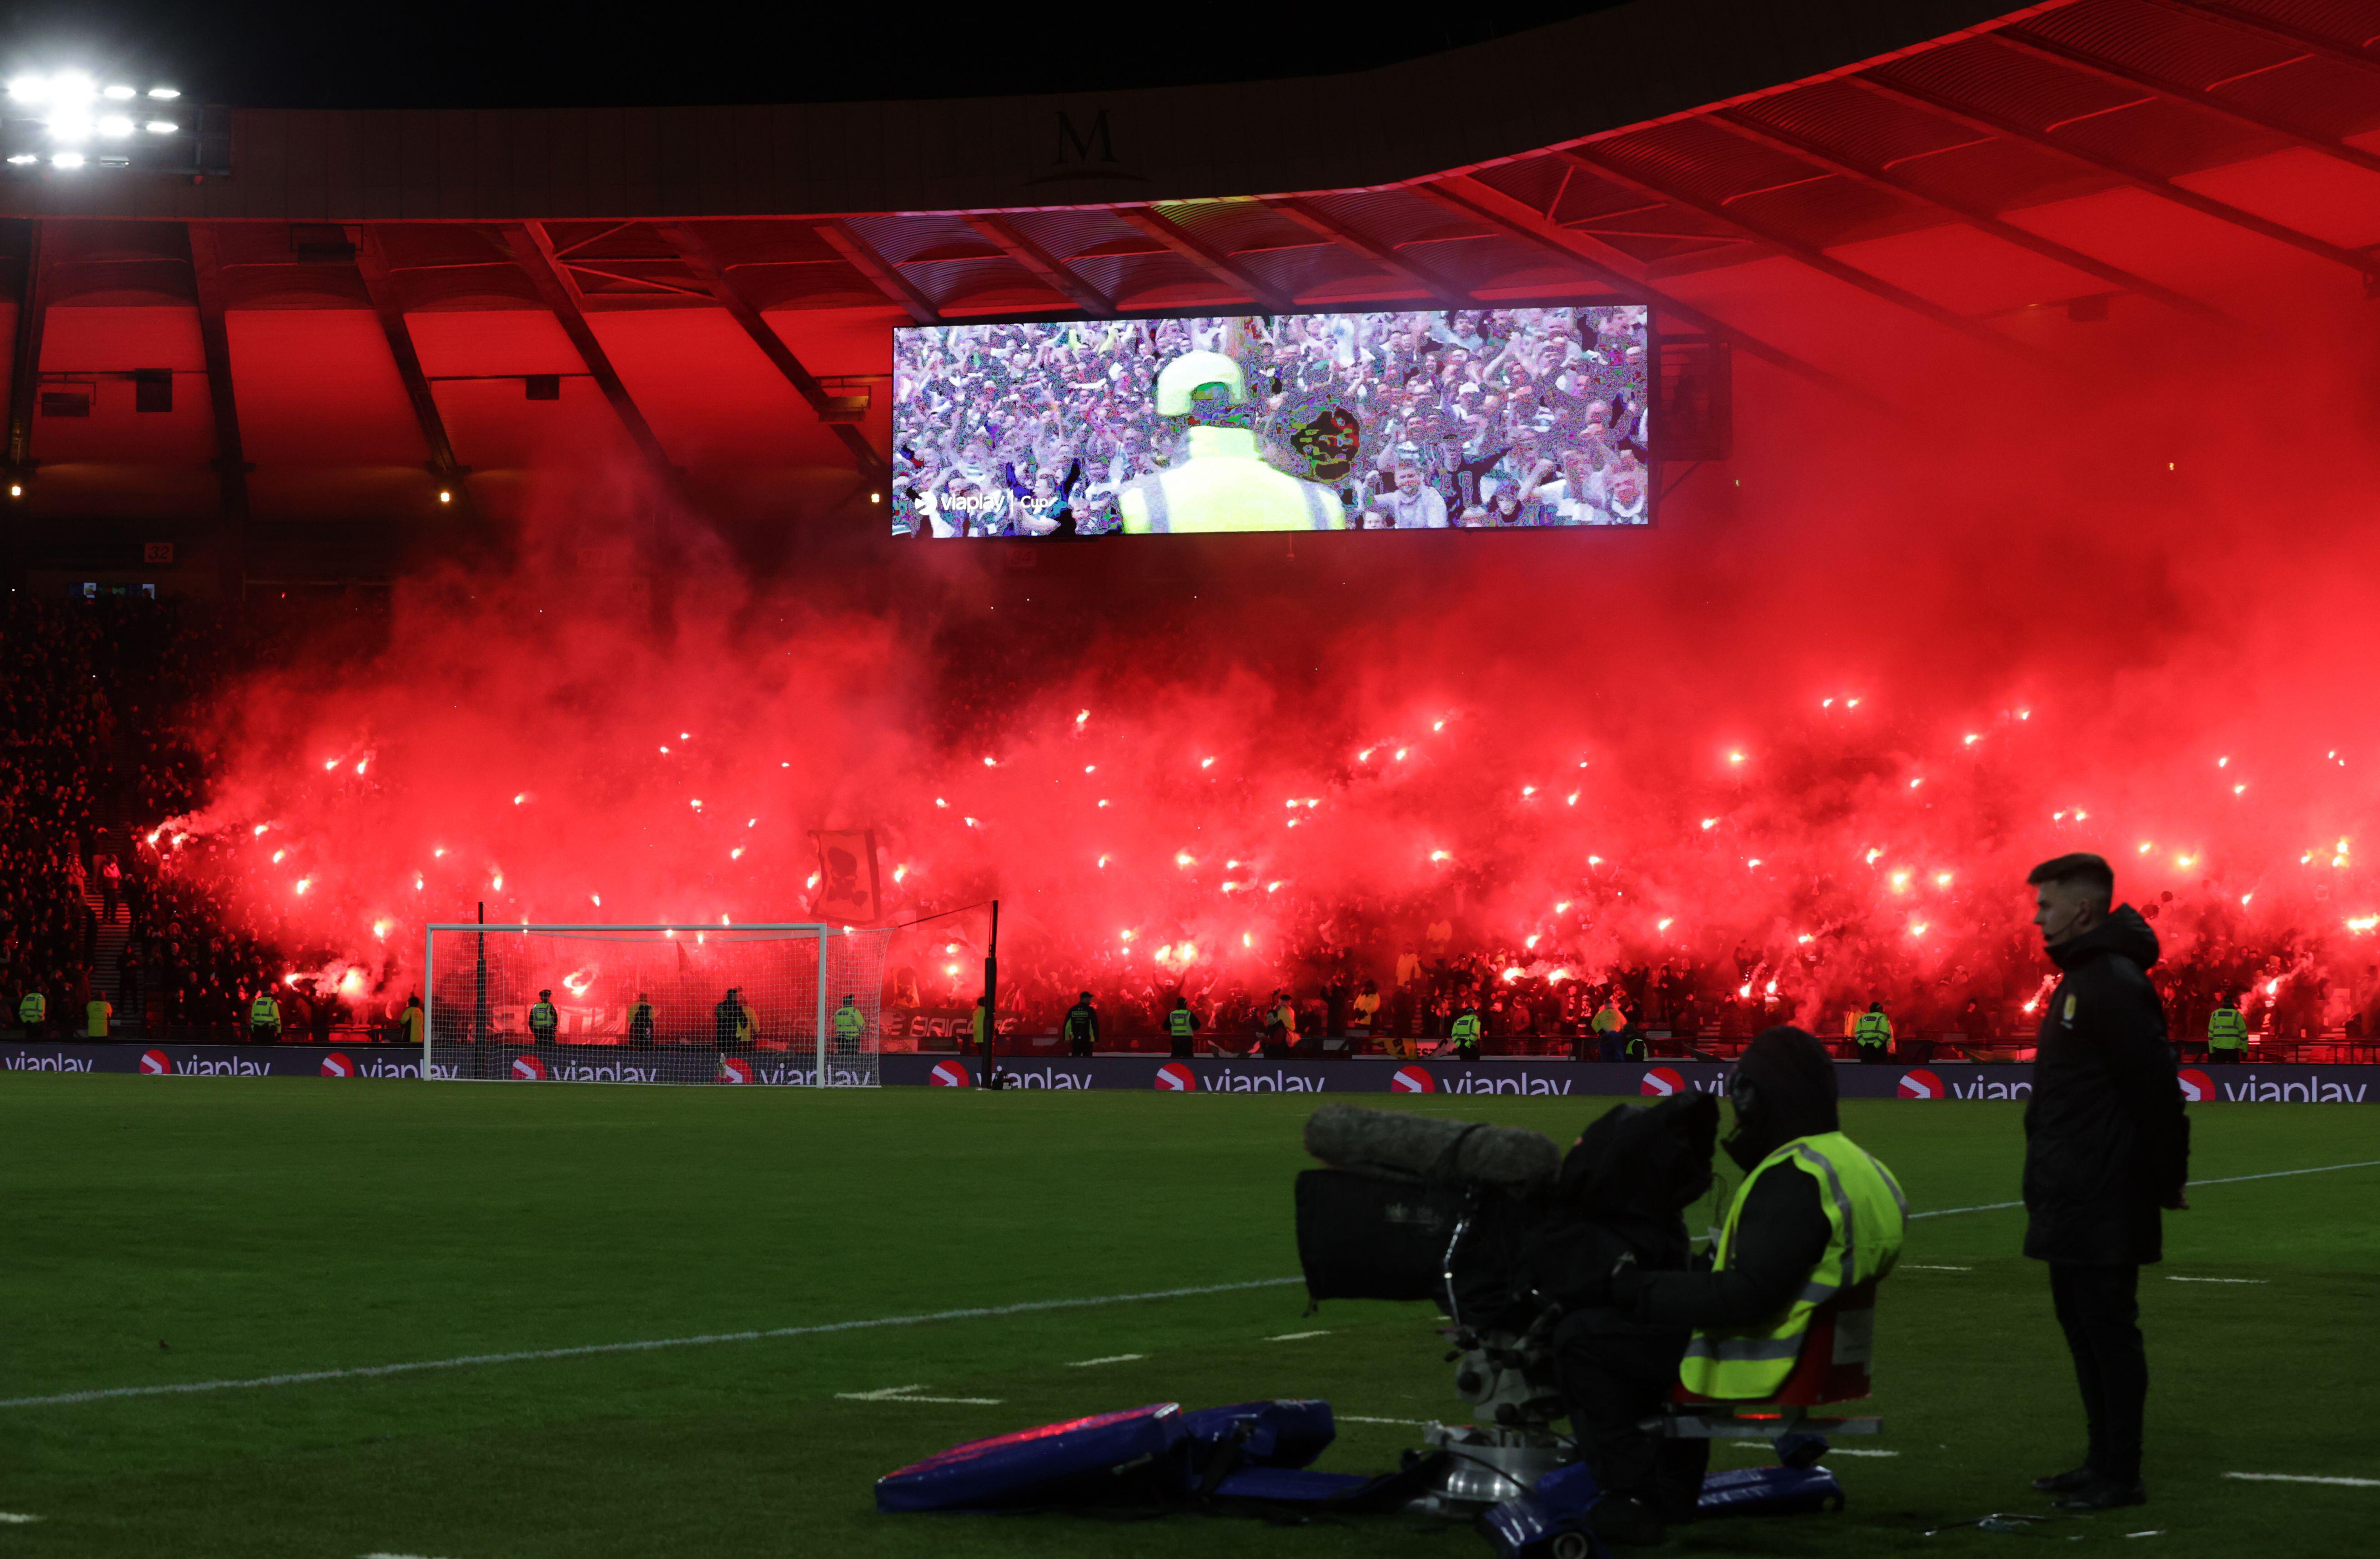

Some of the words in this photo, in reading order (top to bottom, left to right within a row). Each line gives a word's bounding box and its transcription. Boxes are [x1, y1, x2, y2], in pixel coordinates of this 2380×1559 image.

[1053, 109, 1119, 166] M
[940, 493, 1006, 513] viaplay
[1020, 495, 1049, 511] Cup
[148, 546, 169, 559] 32
[910, 1016, 1018, 1037] BRIGE
